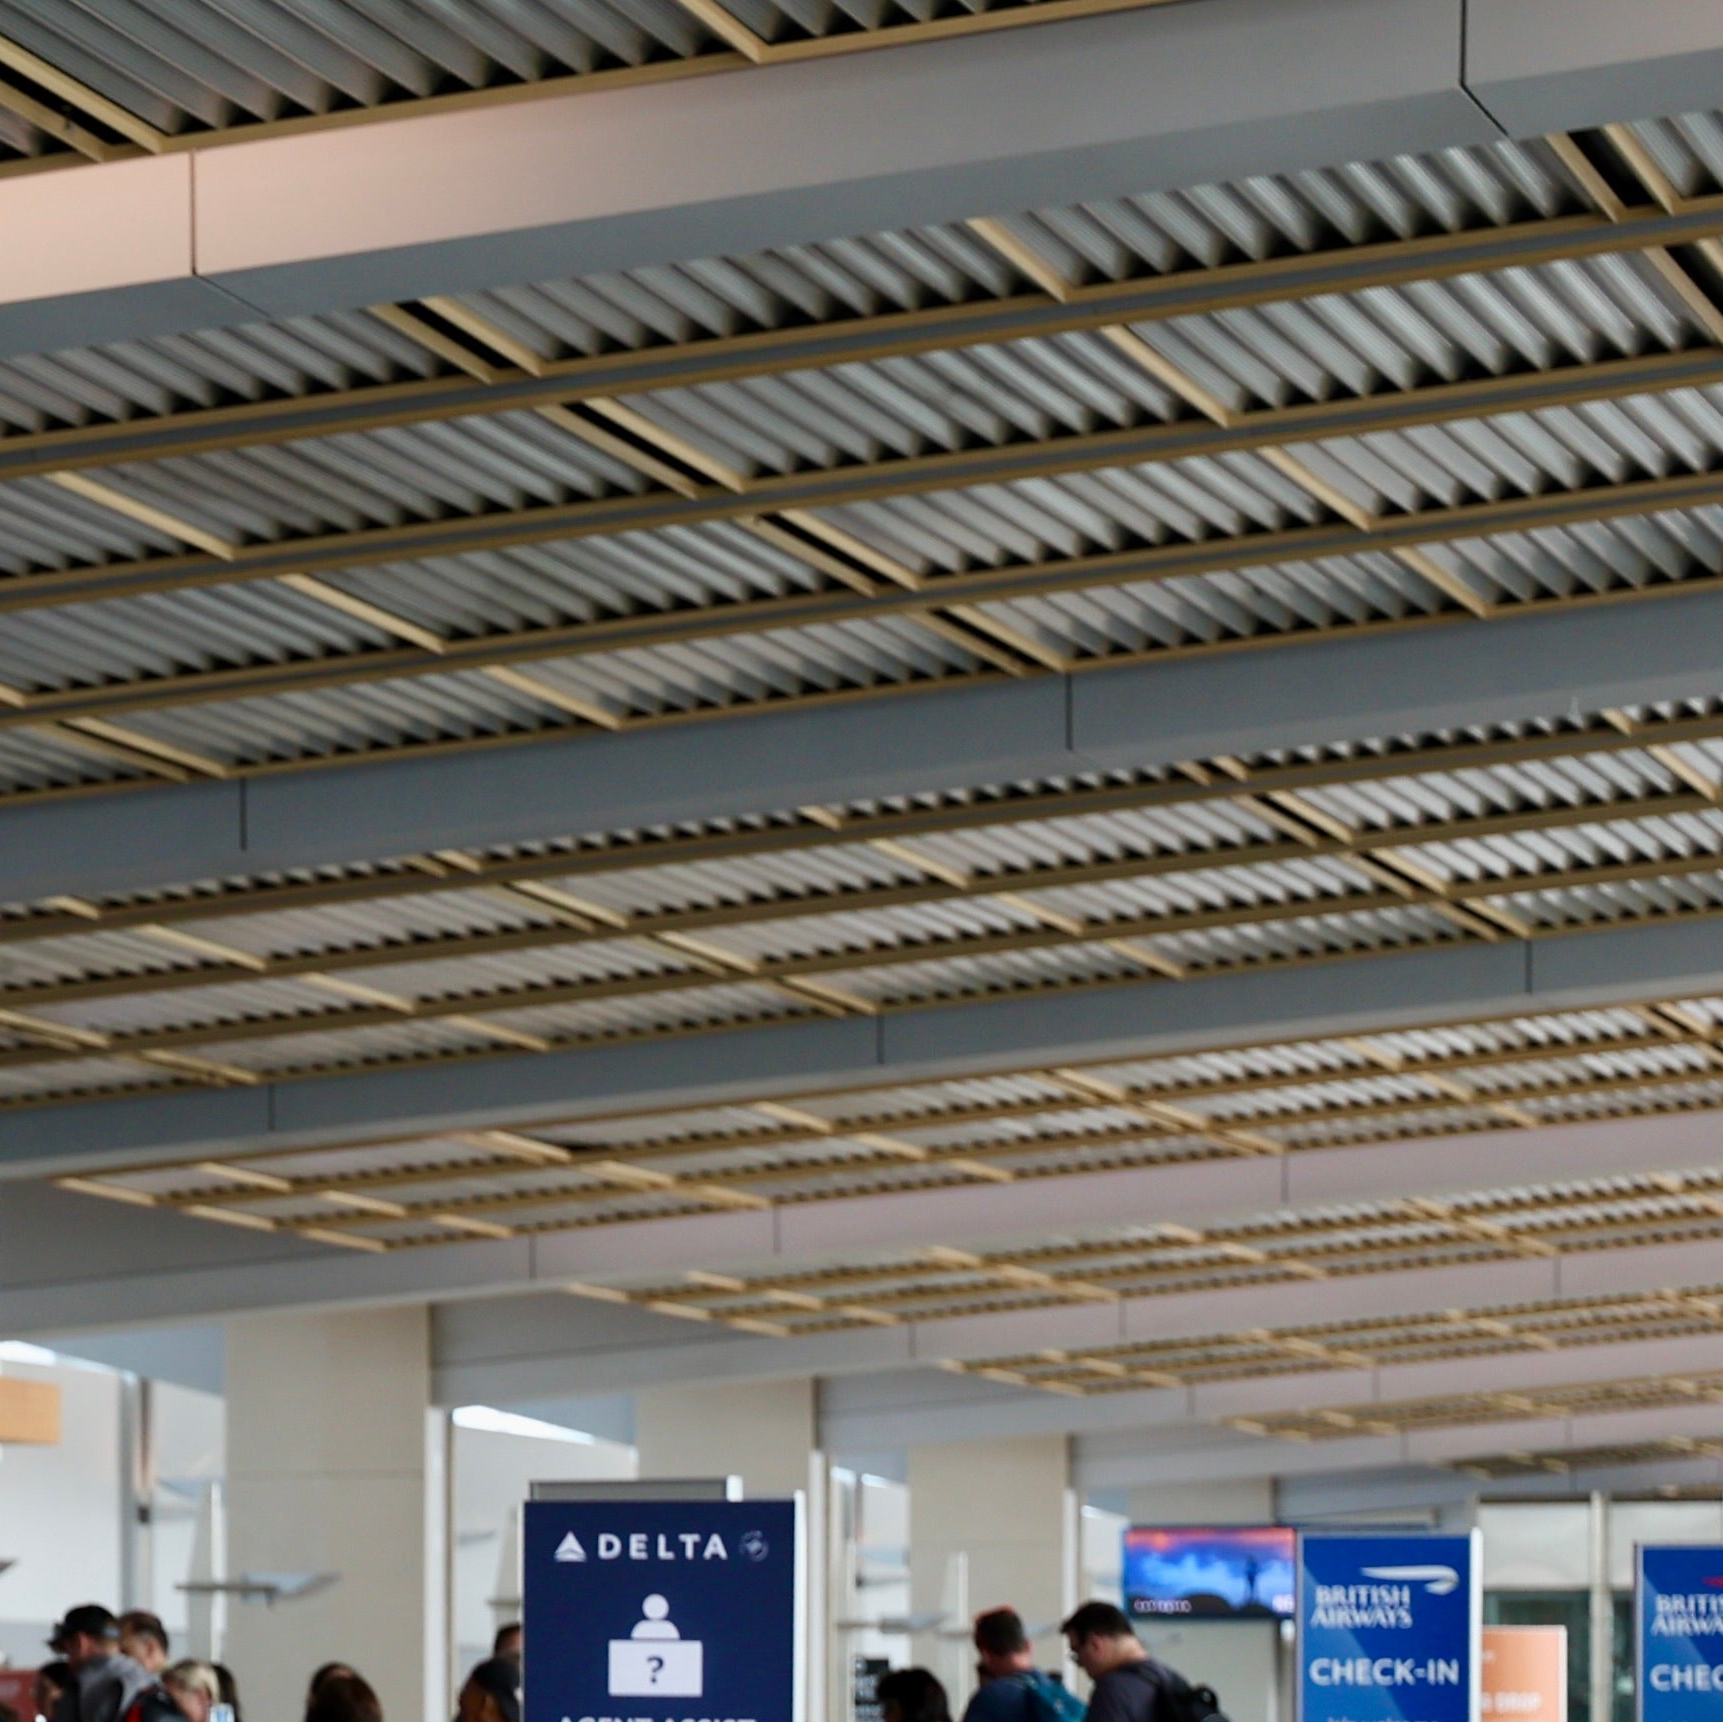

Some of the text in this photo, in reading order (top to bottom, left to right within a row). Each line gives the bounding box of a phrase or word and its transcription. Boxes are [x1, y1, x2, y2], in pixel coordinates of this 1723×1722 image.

[598, 1534, 727, 1560] DELTA
[1315, 1584, 1411, 1608] BRITISH
[1310, 1605, 1413, 1629] AIRWAYS
[1308, 1657, 1460, 1687] CHECK-IN
